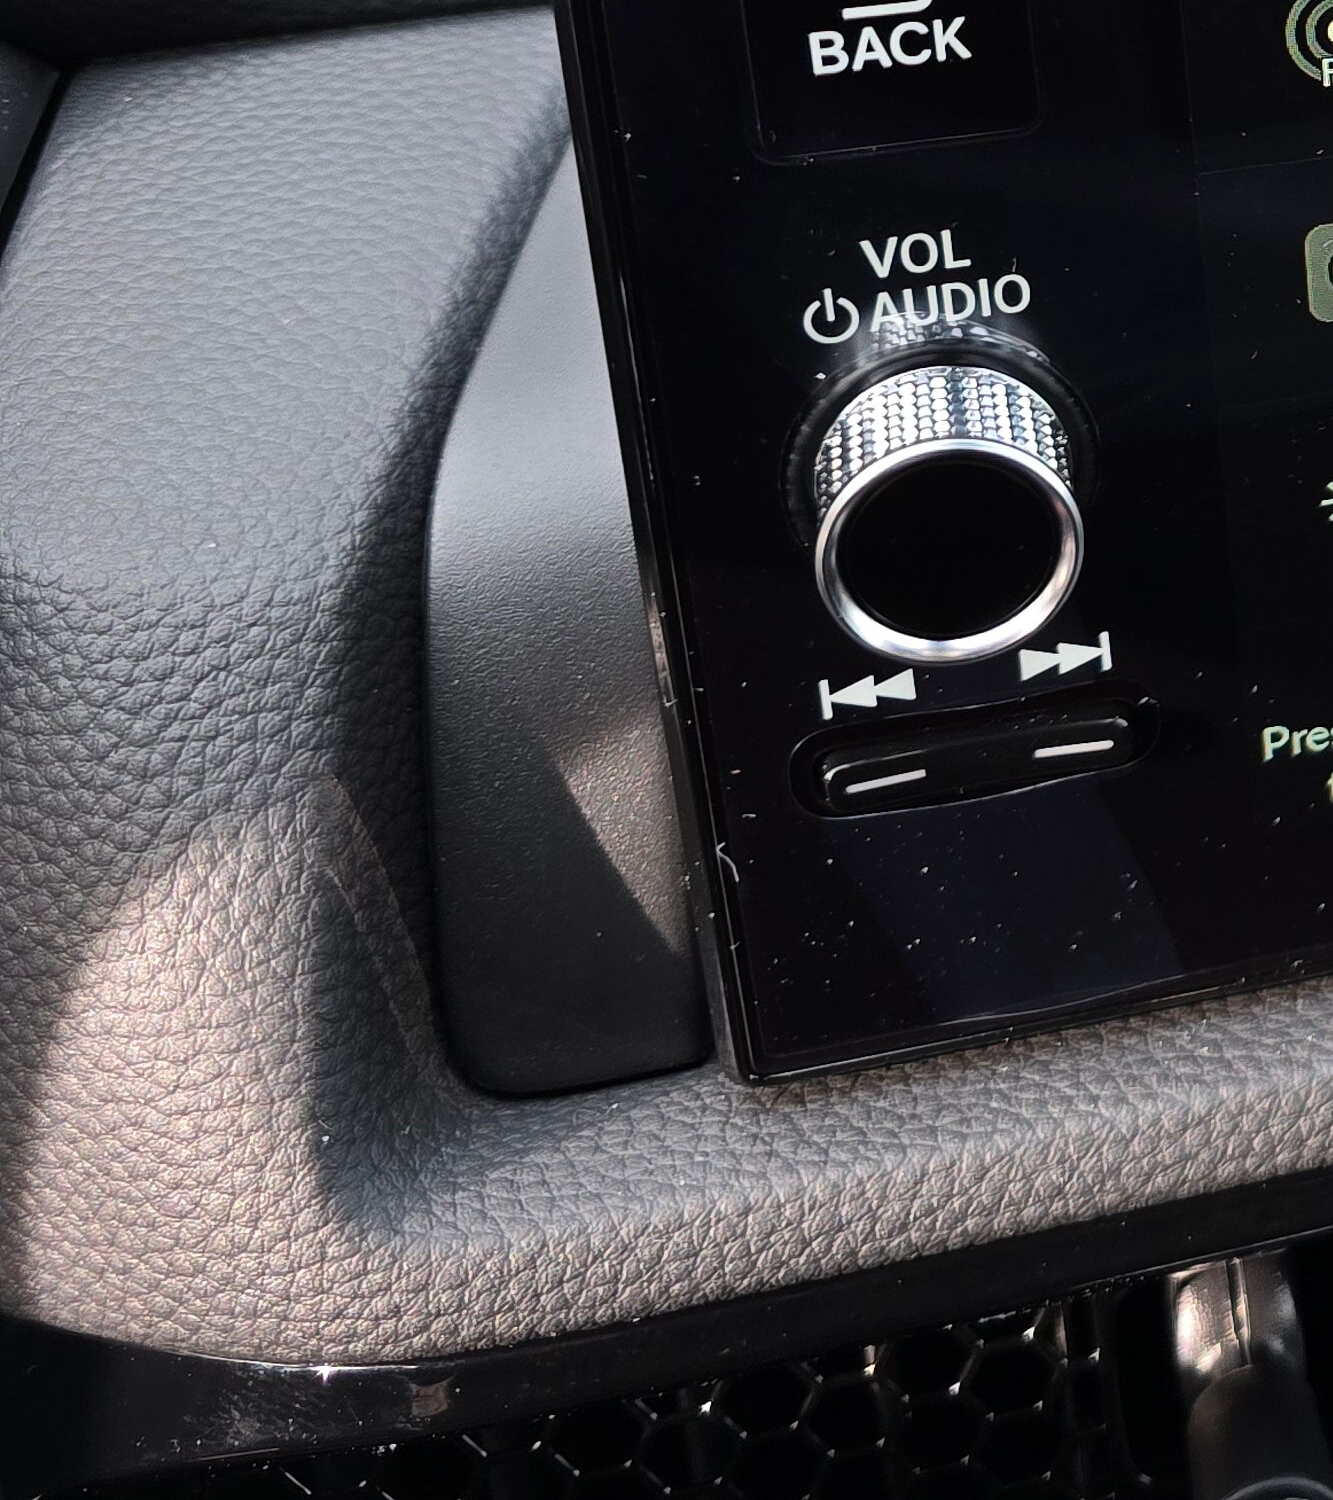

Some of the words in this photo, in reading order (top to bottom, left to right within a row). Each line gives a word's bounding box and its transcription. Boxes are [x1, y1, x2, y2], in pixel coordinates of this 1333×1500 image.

[807, 16, 973, 76] BACK
[859, 229, 972, 278] VOL
[869, 273, 1031, 333] AUDIO
